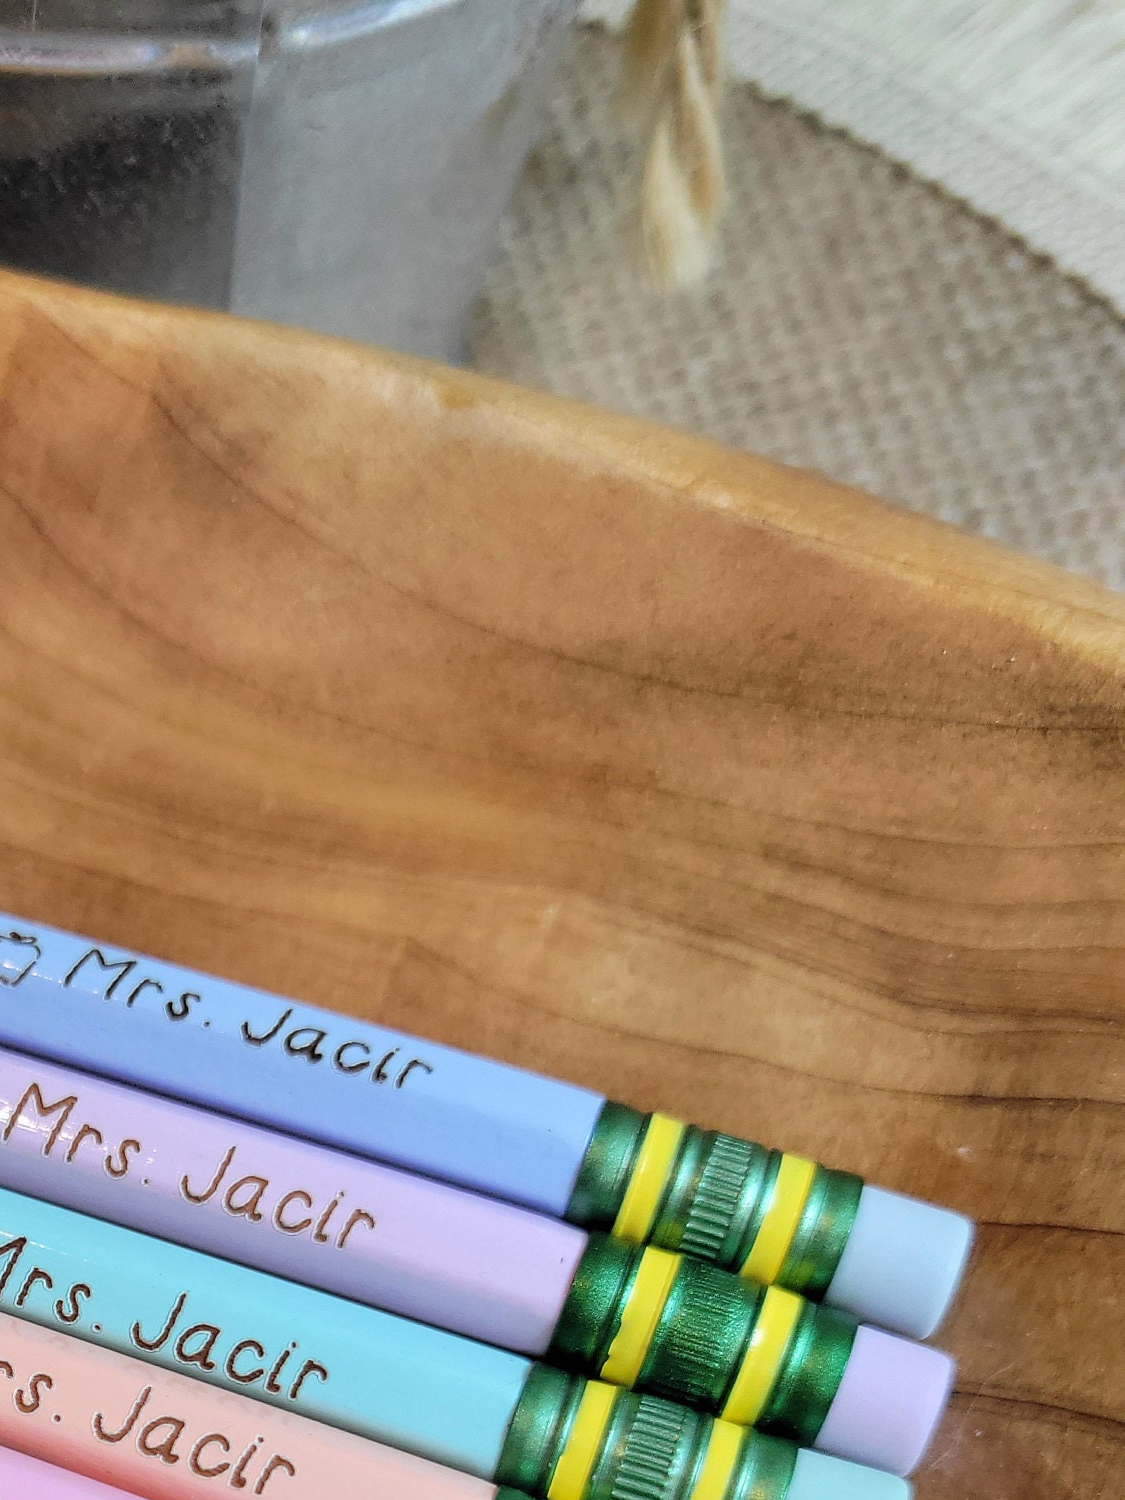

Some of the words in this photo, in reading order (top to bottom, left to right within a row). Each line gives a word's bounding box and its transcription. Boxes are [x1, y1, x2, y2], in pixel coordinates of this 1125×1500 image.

[62, 947, 210, 1029] Mrs.
[239, 1008, 434, 1089] Jacir
[2, 1082, 150, 1186] Mrs.
[180, 1145, 376, 1250] Jacir
[131, 1291, 329, 1400] Jacir
[92, 1385, 296, 1496] Jacir
